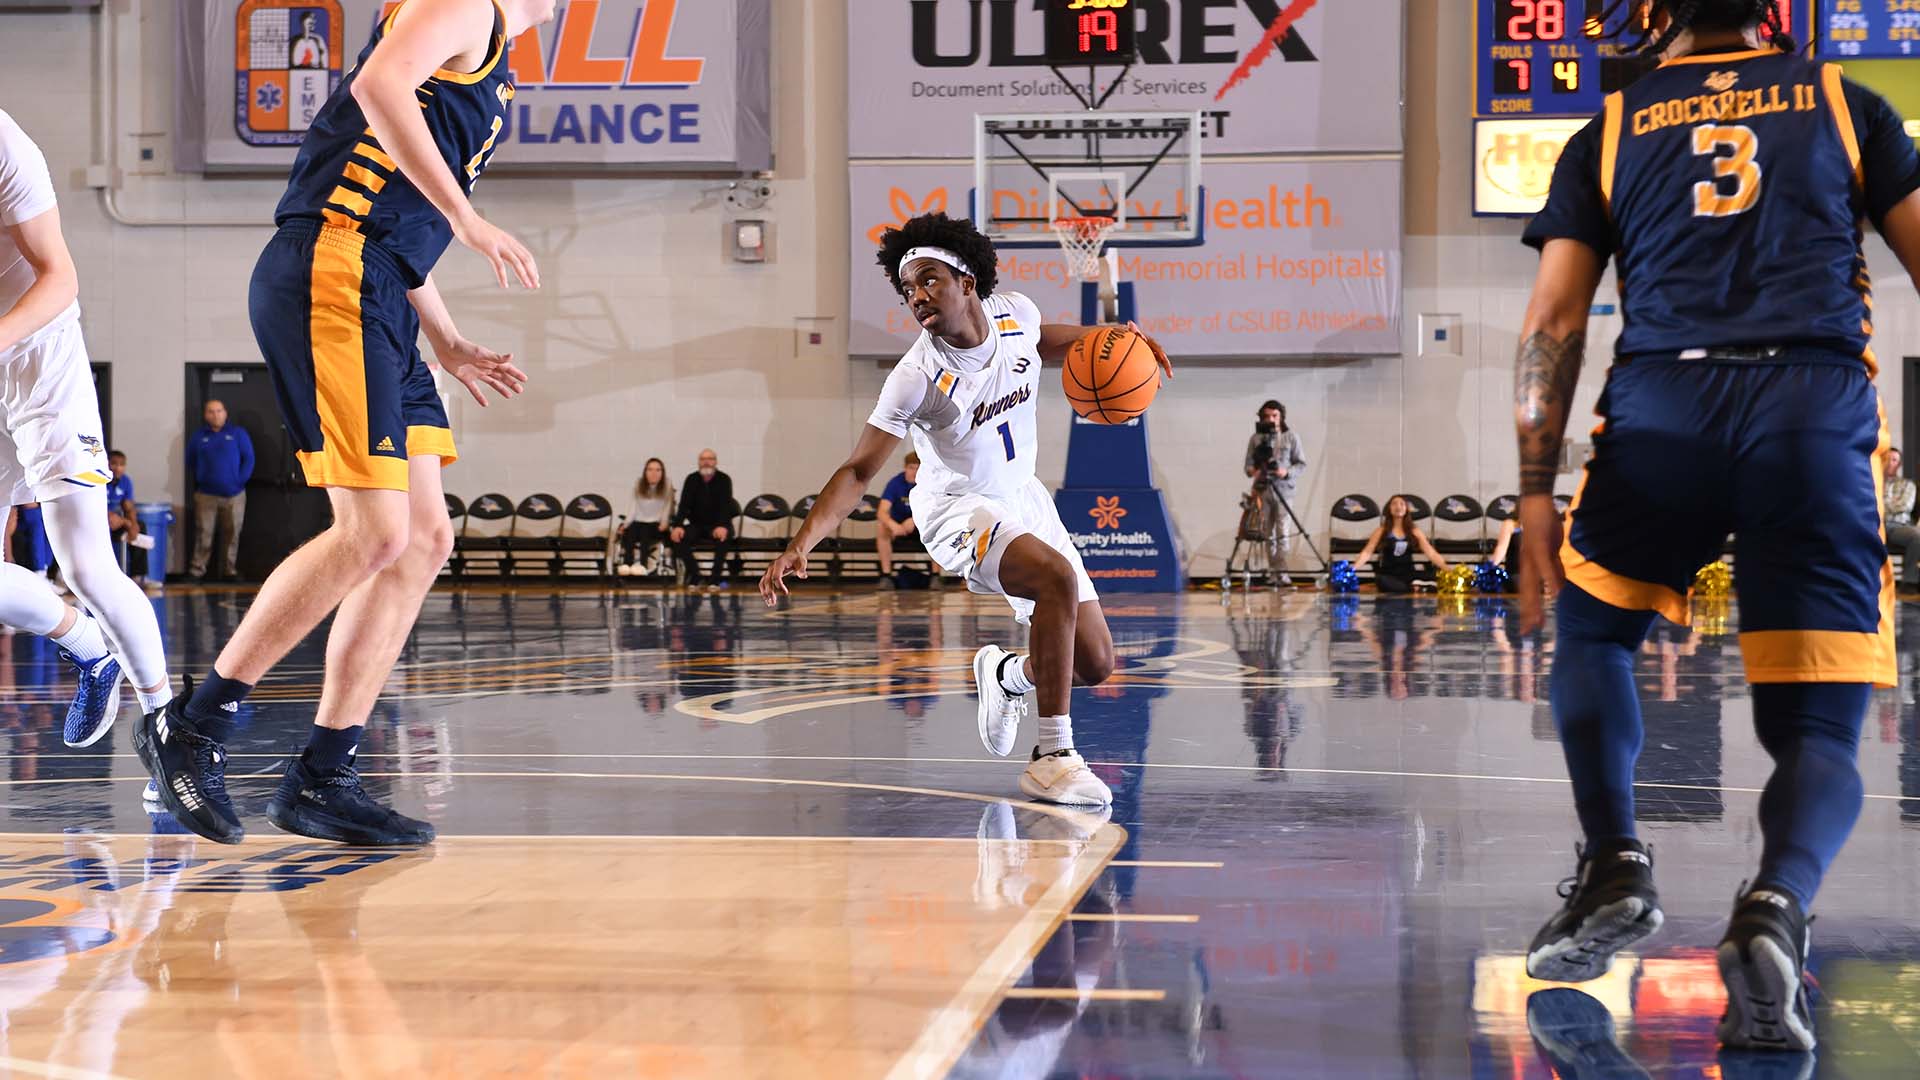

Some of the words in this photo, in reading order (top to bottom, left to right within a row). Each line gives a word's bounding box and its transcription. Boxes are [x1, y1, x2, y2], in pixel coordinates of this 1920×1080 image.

[911, 0, 1319, 67] ULREX
[1078, 10, 1118, 52] 19
[1507, 0, 1565, 41] 28
[1491, 45, 1534, 59] FOULS
[911, 81, 1005, 98] Document
[1009, 79, 1094, 98] Solutions
[1132, 79, 1208, 97] Services
[1507, 59, 1530, 91] 7
[1553, 61, 1578, 90] 4
[1491, 98, 1534, 113] SCORE
[1632, 85, 1789, 137] CROCKRELL
[1691, 123, 1763, 218] 3
[1118, 252, 1246, 281] Memorial
[1256, 248, 1386, 287] Hospitals
[1227, 308, 1292, 334] CSUB
[970, 382, 1032, 431] Runners
[996, 420, 1016, 462] 1
